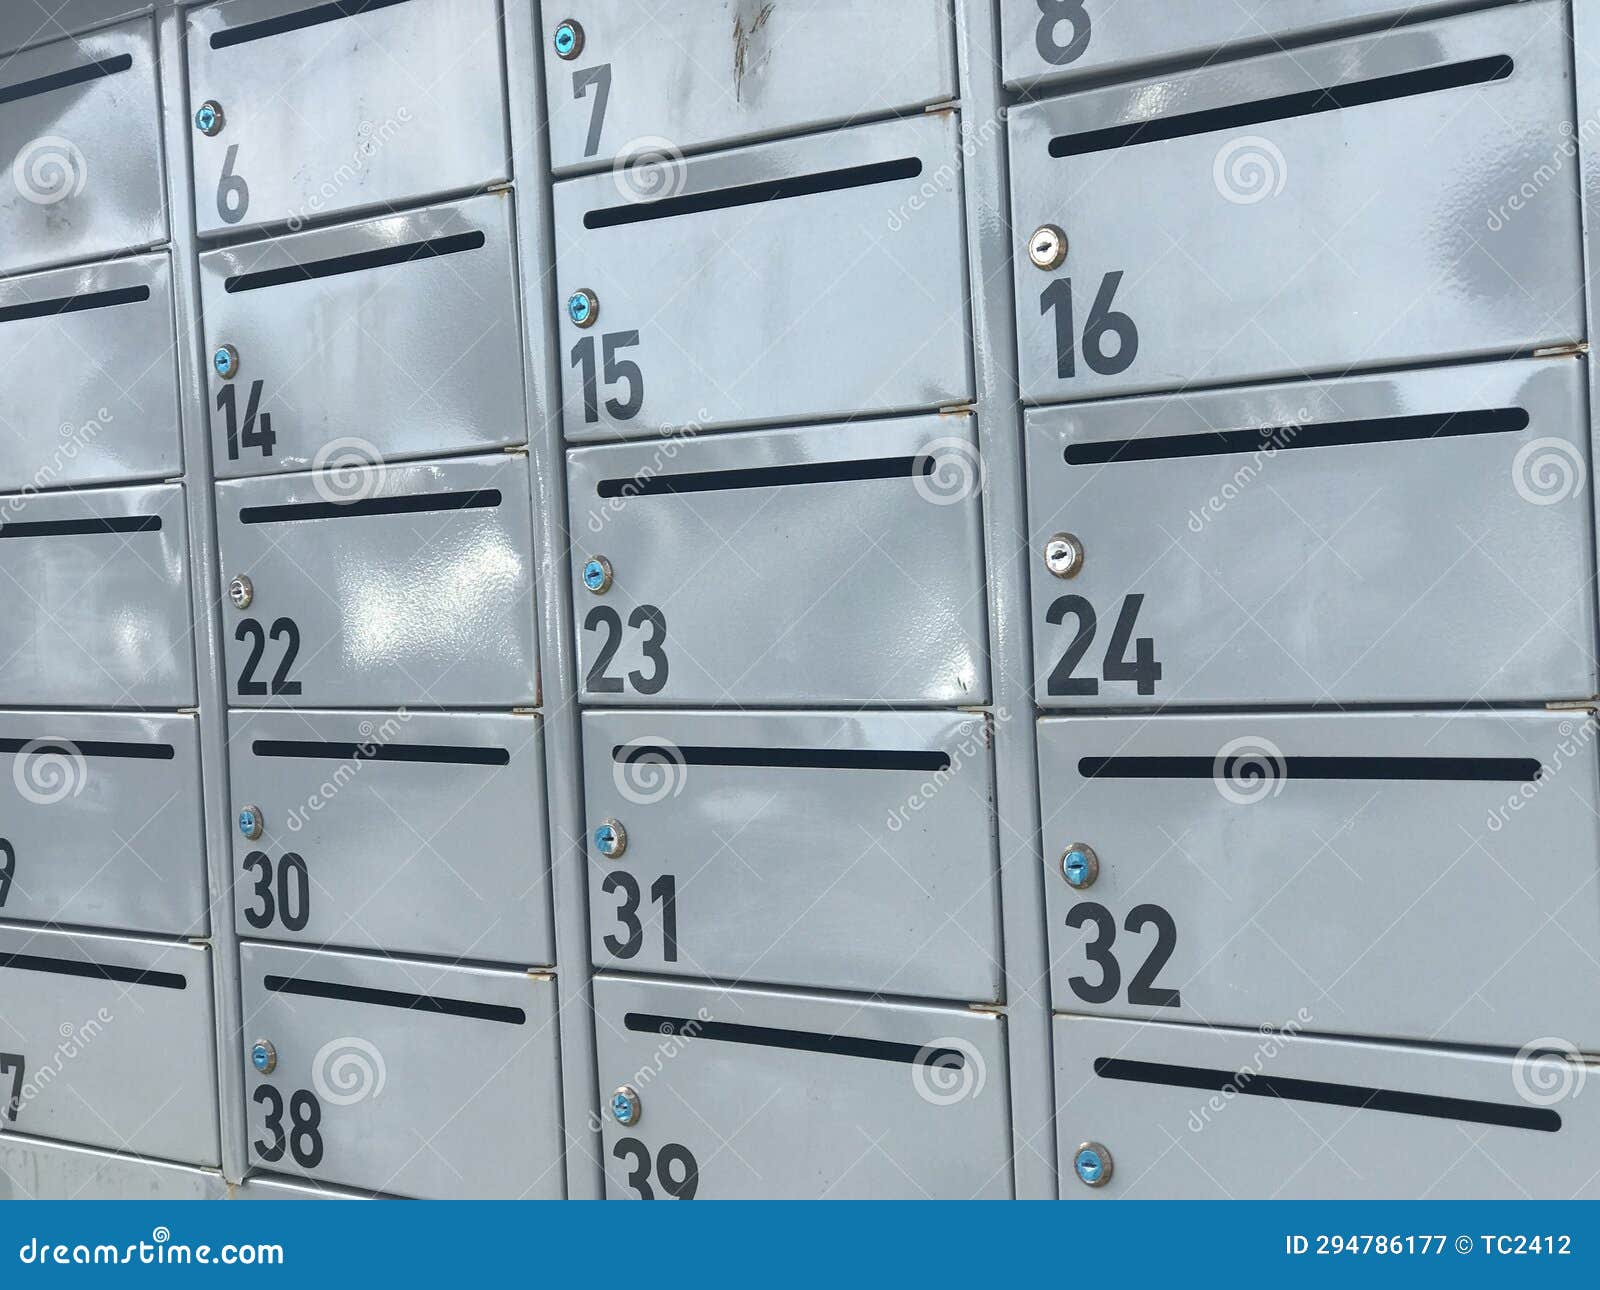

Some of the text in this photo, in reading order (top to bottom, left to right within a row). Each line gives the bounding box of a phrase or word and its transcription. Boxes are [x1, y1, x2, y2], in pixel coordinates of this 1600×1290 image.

[1036, 0, 1092, 66] 8
[572, 63, 612, 158] 7
[216, 143, 250, 225] 6
[1040, 270, 1139, 380] 16
[216, 379, 277, 461] 14
[571, 329, 644, 423] 15
[235, 617, 302, 696] 22
[584, 604, 669, 695] 23
[1046, 593, 1163, 696] 24
[243, 850, 310, 931] 30
[602, 870, 678, 963] 31
[1065, 901, 1181, 1008] 32
[253, 1083, 324, 1169] 38
[613, 1137, 699, 1200] 39
